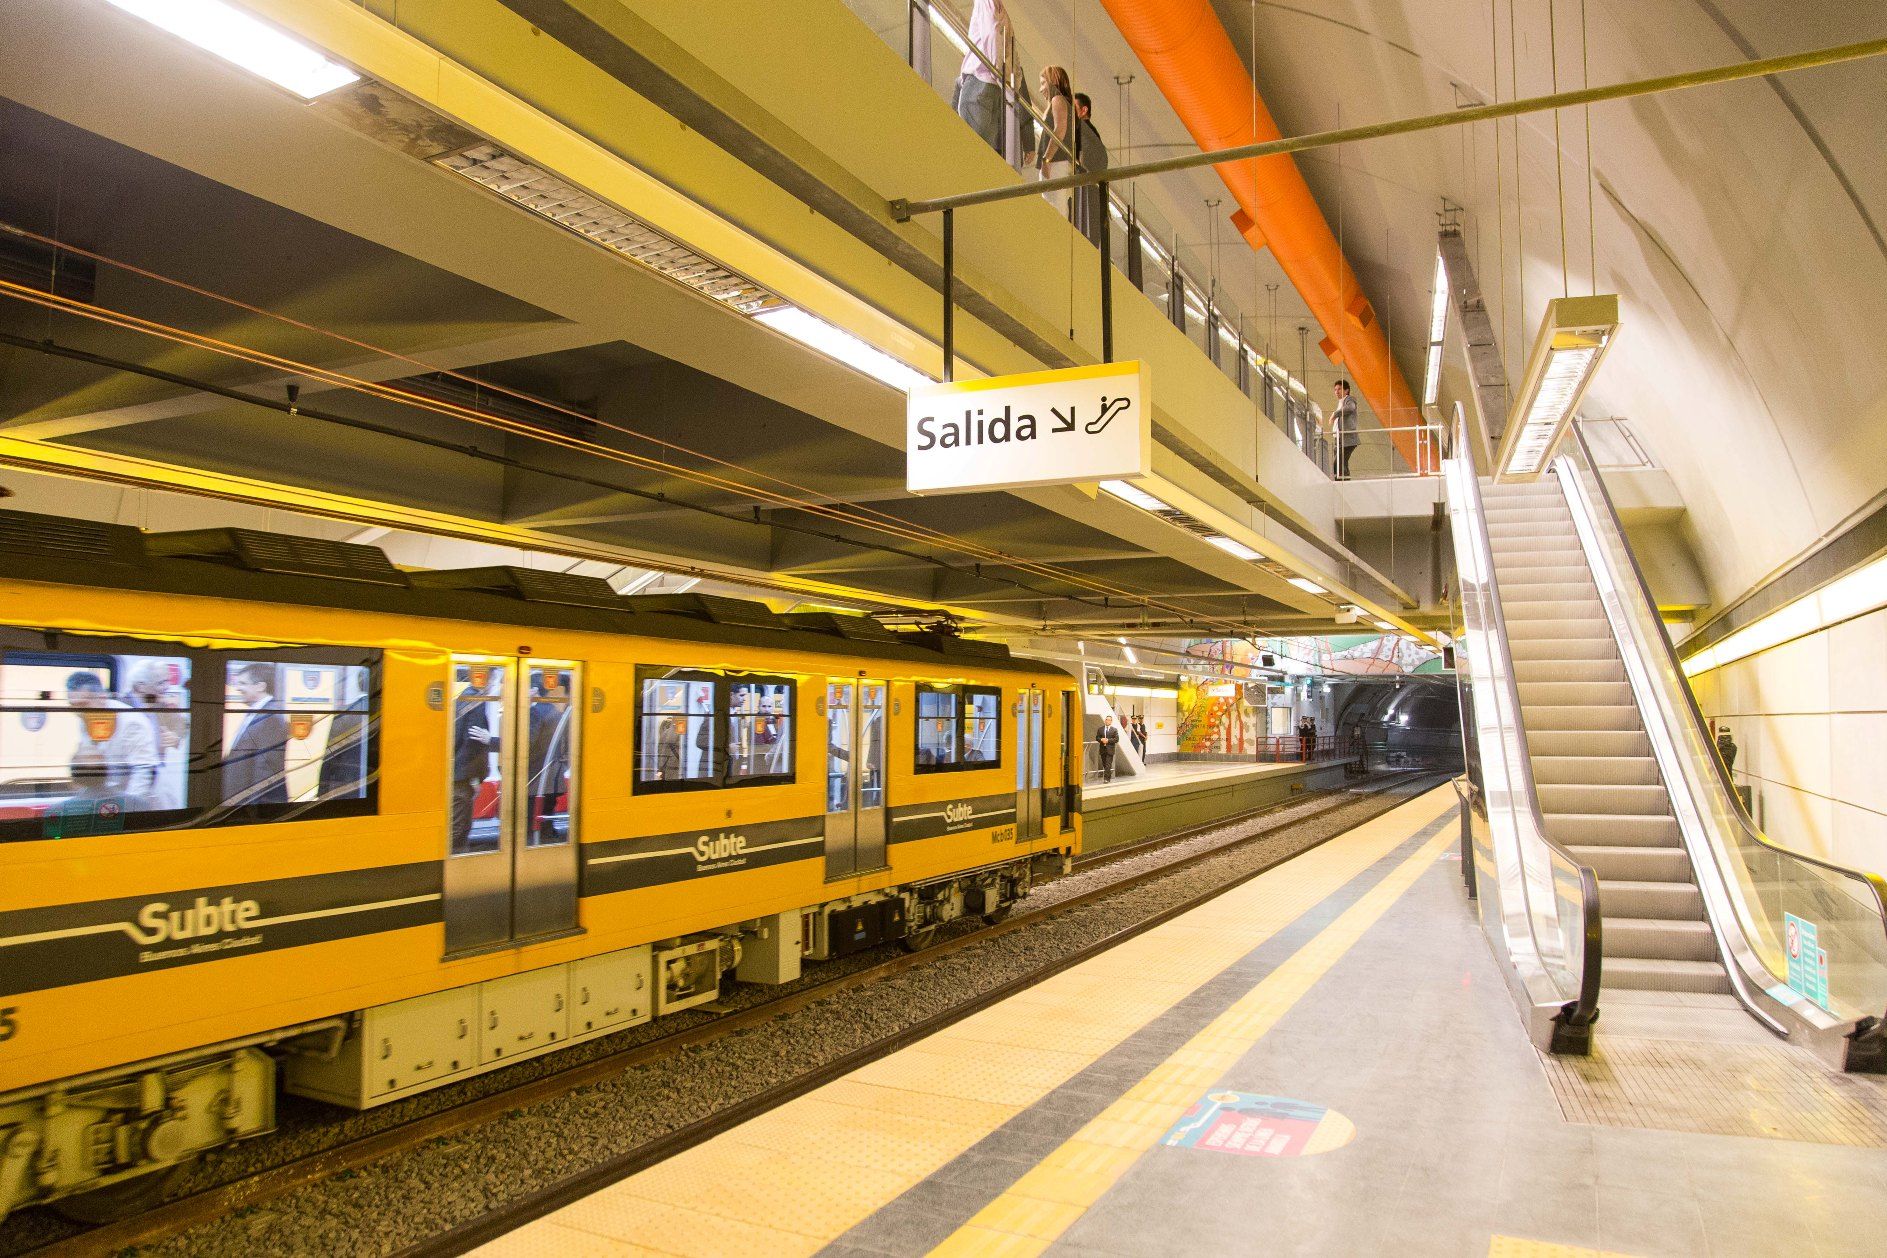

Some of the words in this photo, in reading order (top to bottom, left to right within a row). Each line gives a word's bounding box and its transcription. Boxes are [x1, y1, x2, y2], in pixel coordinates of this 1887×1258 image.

[917, 405, 1037, 450] Salida
[946, 803, 973, 823] Subte
[695, 832, 747, 861] Subte
[134, 897, 261, 945] Subte
